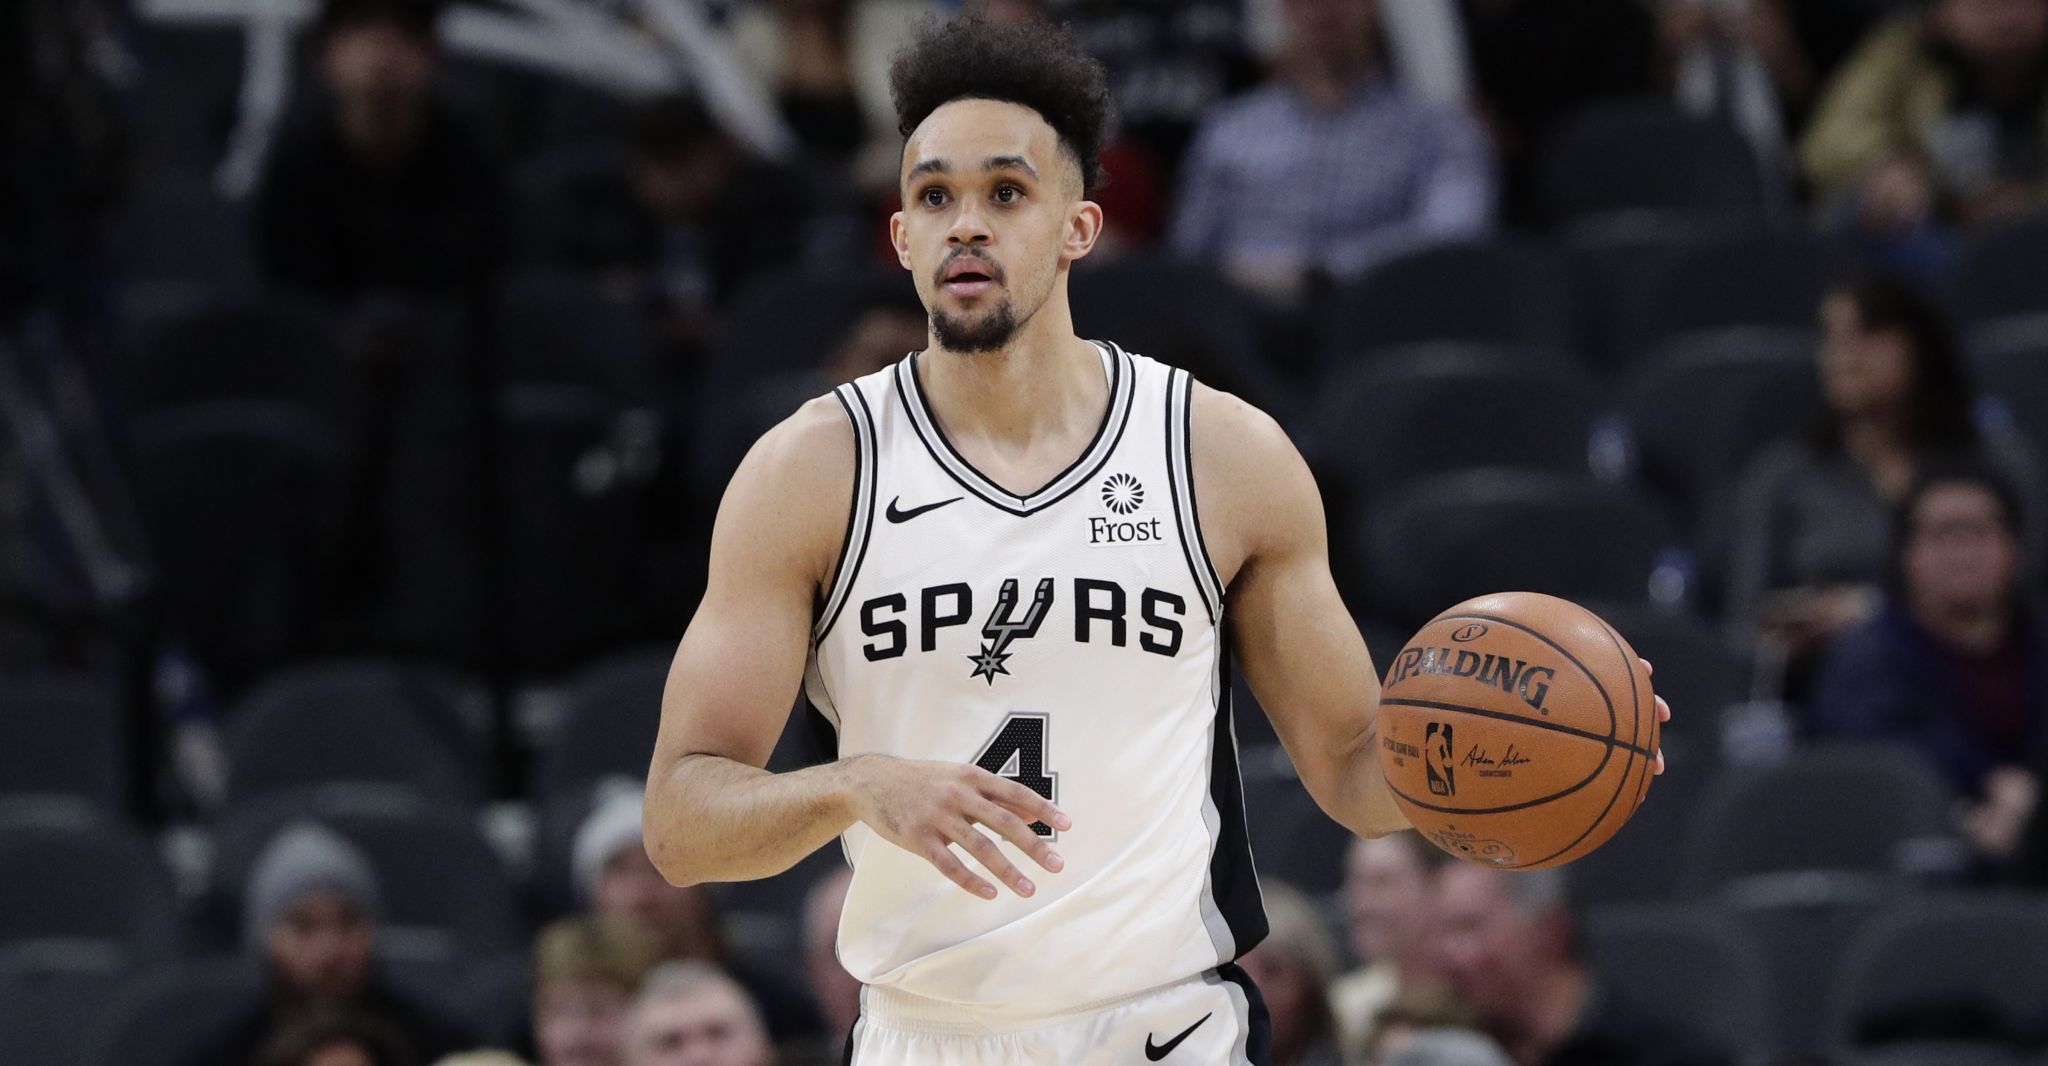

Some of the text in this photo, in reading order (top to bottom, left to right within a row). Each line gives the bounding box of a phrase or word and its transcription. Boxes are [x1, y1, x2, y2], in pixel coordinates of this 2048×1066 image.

[1089, 517, 1162, 543] Frost
[860, 577, 1186, 686] SPURS
[1387, 647, 1555, 711] SPALDING
[969, 711, 1058, 842] 4
[1431, 780, 1446, 793] NBA
